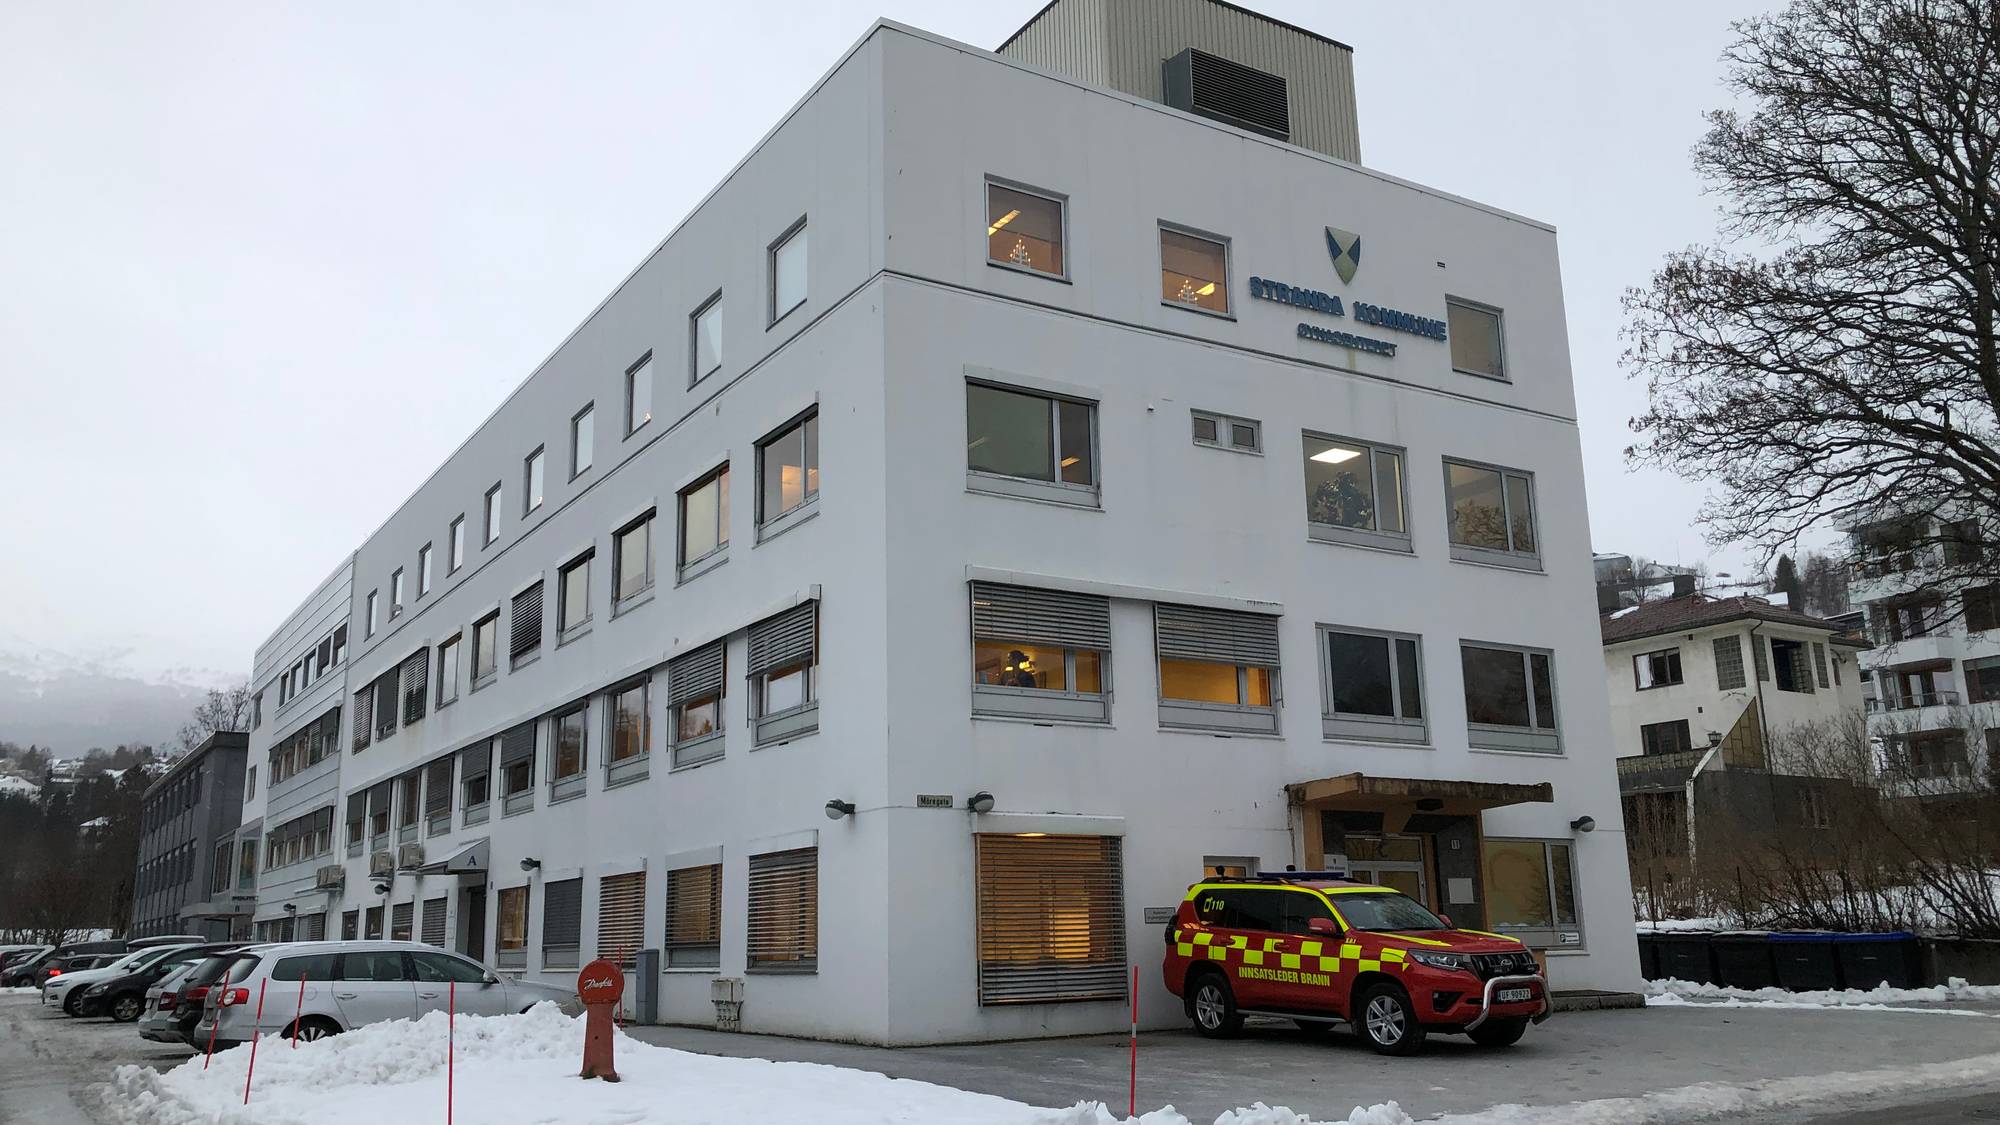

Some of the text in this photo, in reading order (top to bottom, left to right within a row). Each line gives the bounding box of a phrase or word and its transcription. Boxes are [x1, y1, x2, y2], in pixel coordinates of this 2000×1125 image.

[1249, 276, 1447, 341] STRANDA KOMMUNE
[467, 855, 477, 866] A
[1211, 899, 1225, 911] 110
[1239, 966, 1330, 987] INNSATSLEDER BRANN
